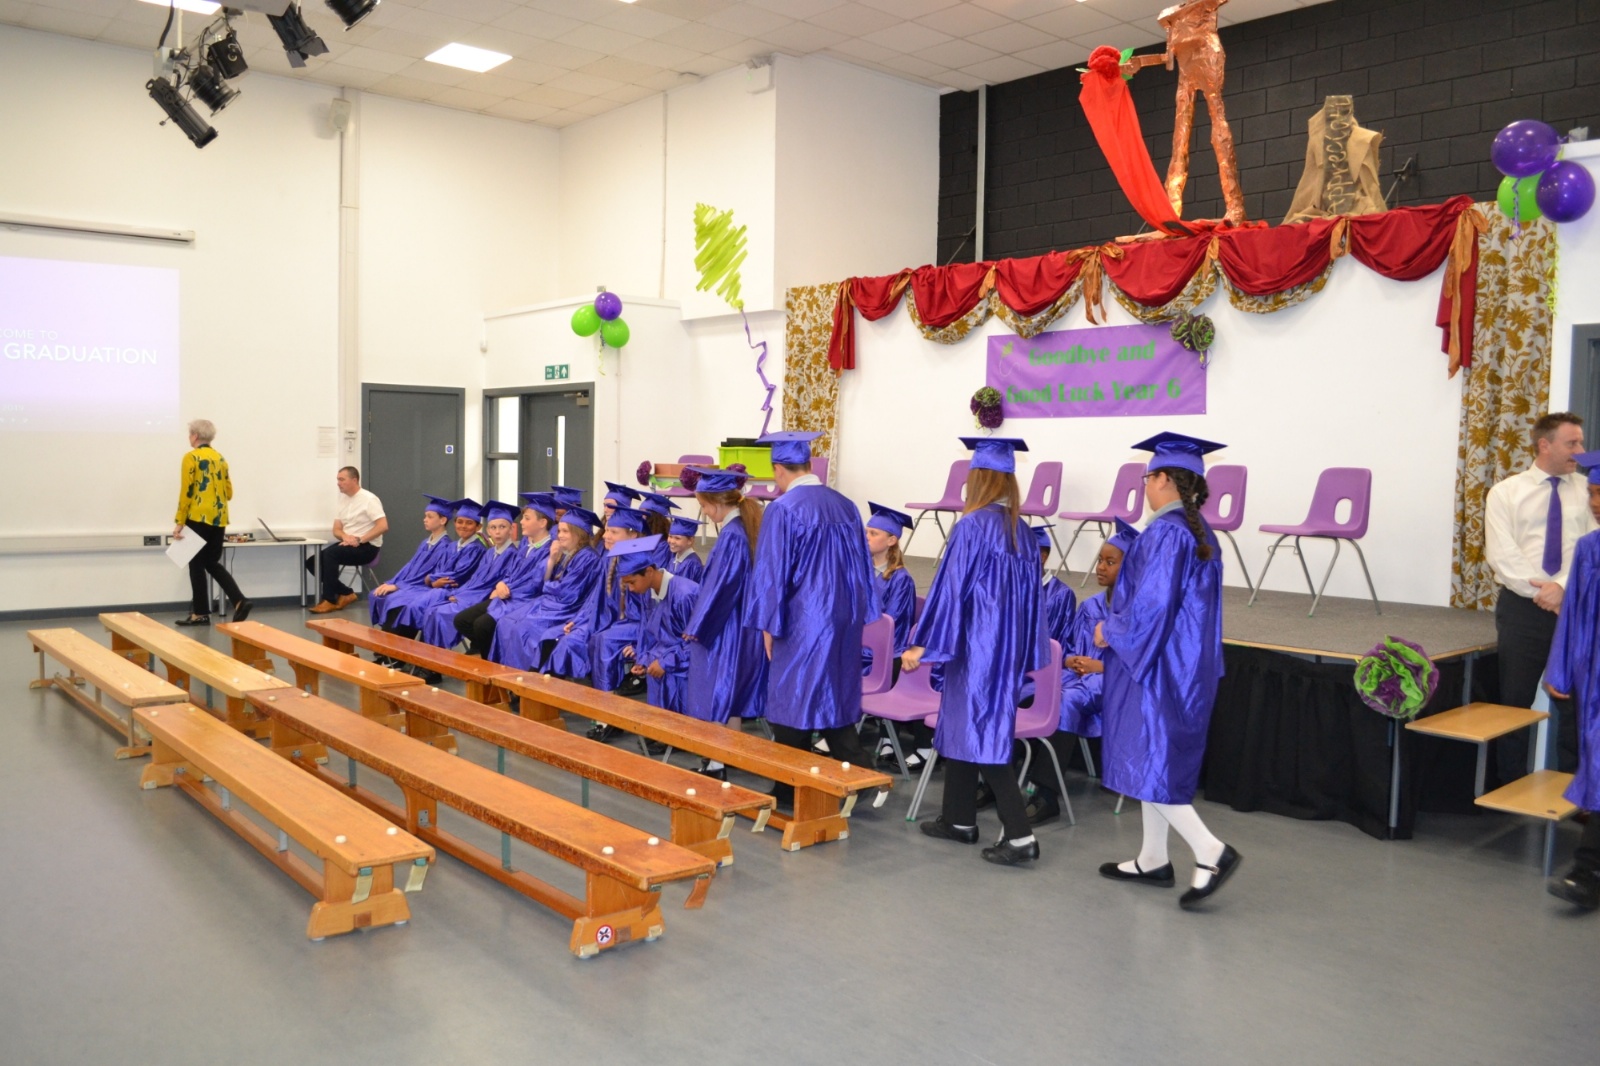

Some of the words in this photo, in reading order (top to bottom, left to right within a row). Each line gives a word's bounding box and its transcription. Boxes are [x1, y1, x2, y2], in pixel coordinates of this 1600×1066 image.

[0, 328, 34, 339] OME
[40, 330, 58, 340] TO
[4, 342, 158, 365] GRADUATION
[1028, 344, 1110, 368] Goodbye
[1117, 340, 1156, 361] and
[1006, 384, 1052, 403] Good
[1058, 381, 1105, 402] Luck
[1111, 381, 1159, 401] Year
[1167, 378, 1182, 399] 6
